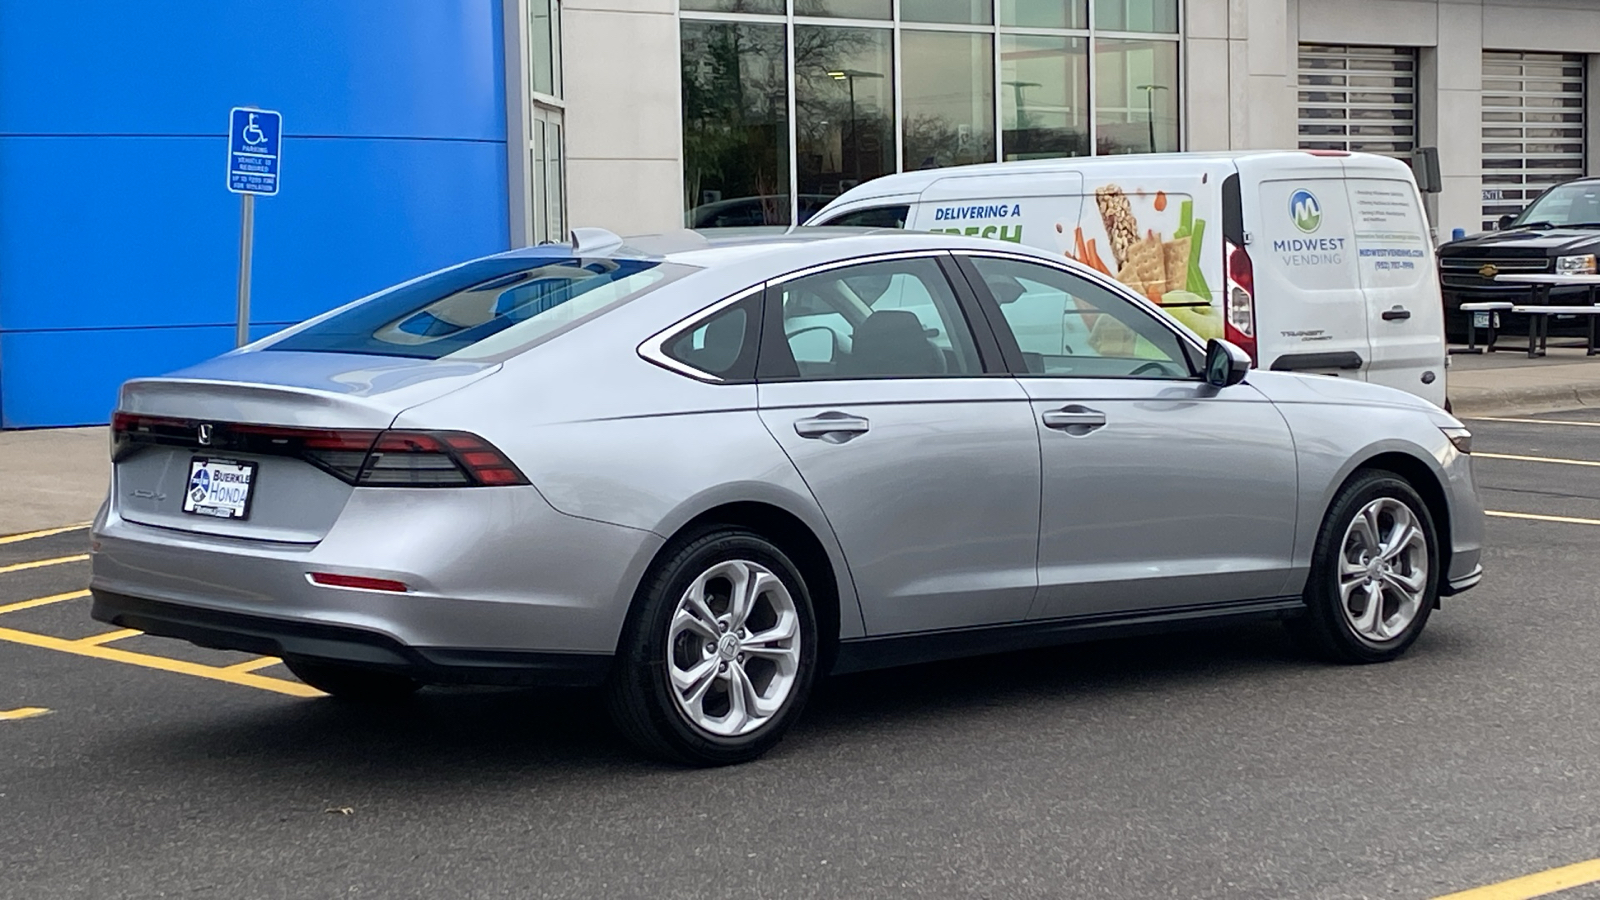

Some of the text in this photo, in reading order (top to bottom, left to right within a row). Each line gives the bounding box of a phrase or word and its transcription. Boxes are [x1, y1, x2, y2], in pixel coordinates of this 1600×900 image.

[242, 145, 268, 153] PARKING
[239, 164, 269, 172] REQUIRED
[935, 204, 1021, 220] DELIVERING A
[1273, 238, 1345, 252] MIDWEST
[1282, 253, 1342, 266] VENDING
[1359, 248, 1424, 258] MIDWESTVENDING.COM
[213, 469, 251, 484] BUERKLE
[209, 482, 246, 504] HONDA
